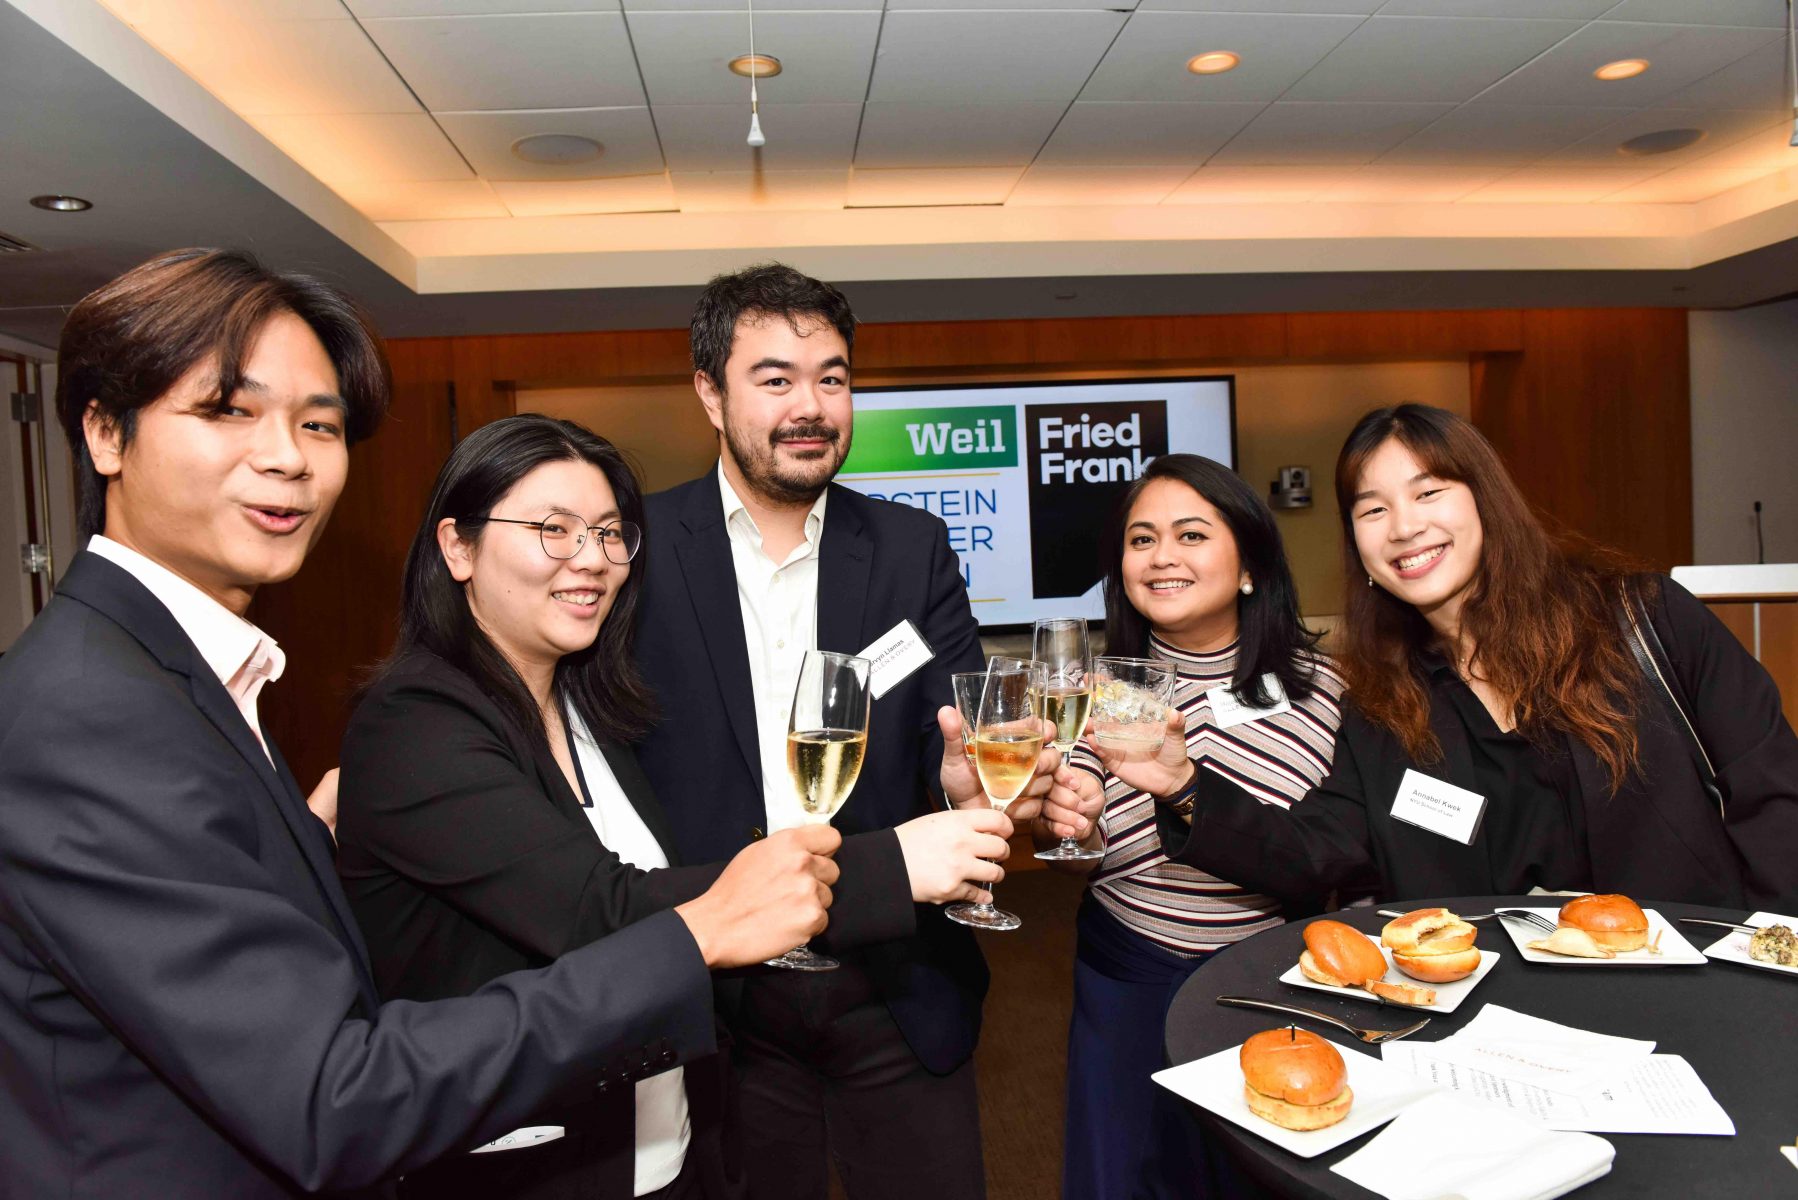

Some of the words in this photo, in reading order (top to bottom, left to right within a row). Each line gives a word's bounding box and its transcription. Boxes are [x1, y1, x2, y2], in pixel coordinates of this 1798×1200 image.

[905, 418, 1006, 456] Weil
[1039, 413, 1141, 449] Fried
[1040, 447, 1157, 485] Frank
[1412, 789, 1441, 804] Annabel
[1442, 801, 1461, 812] Kwek
